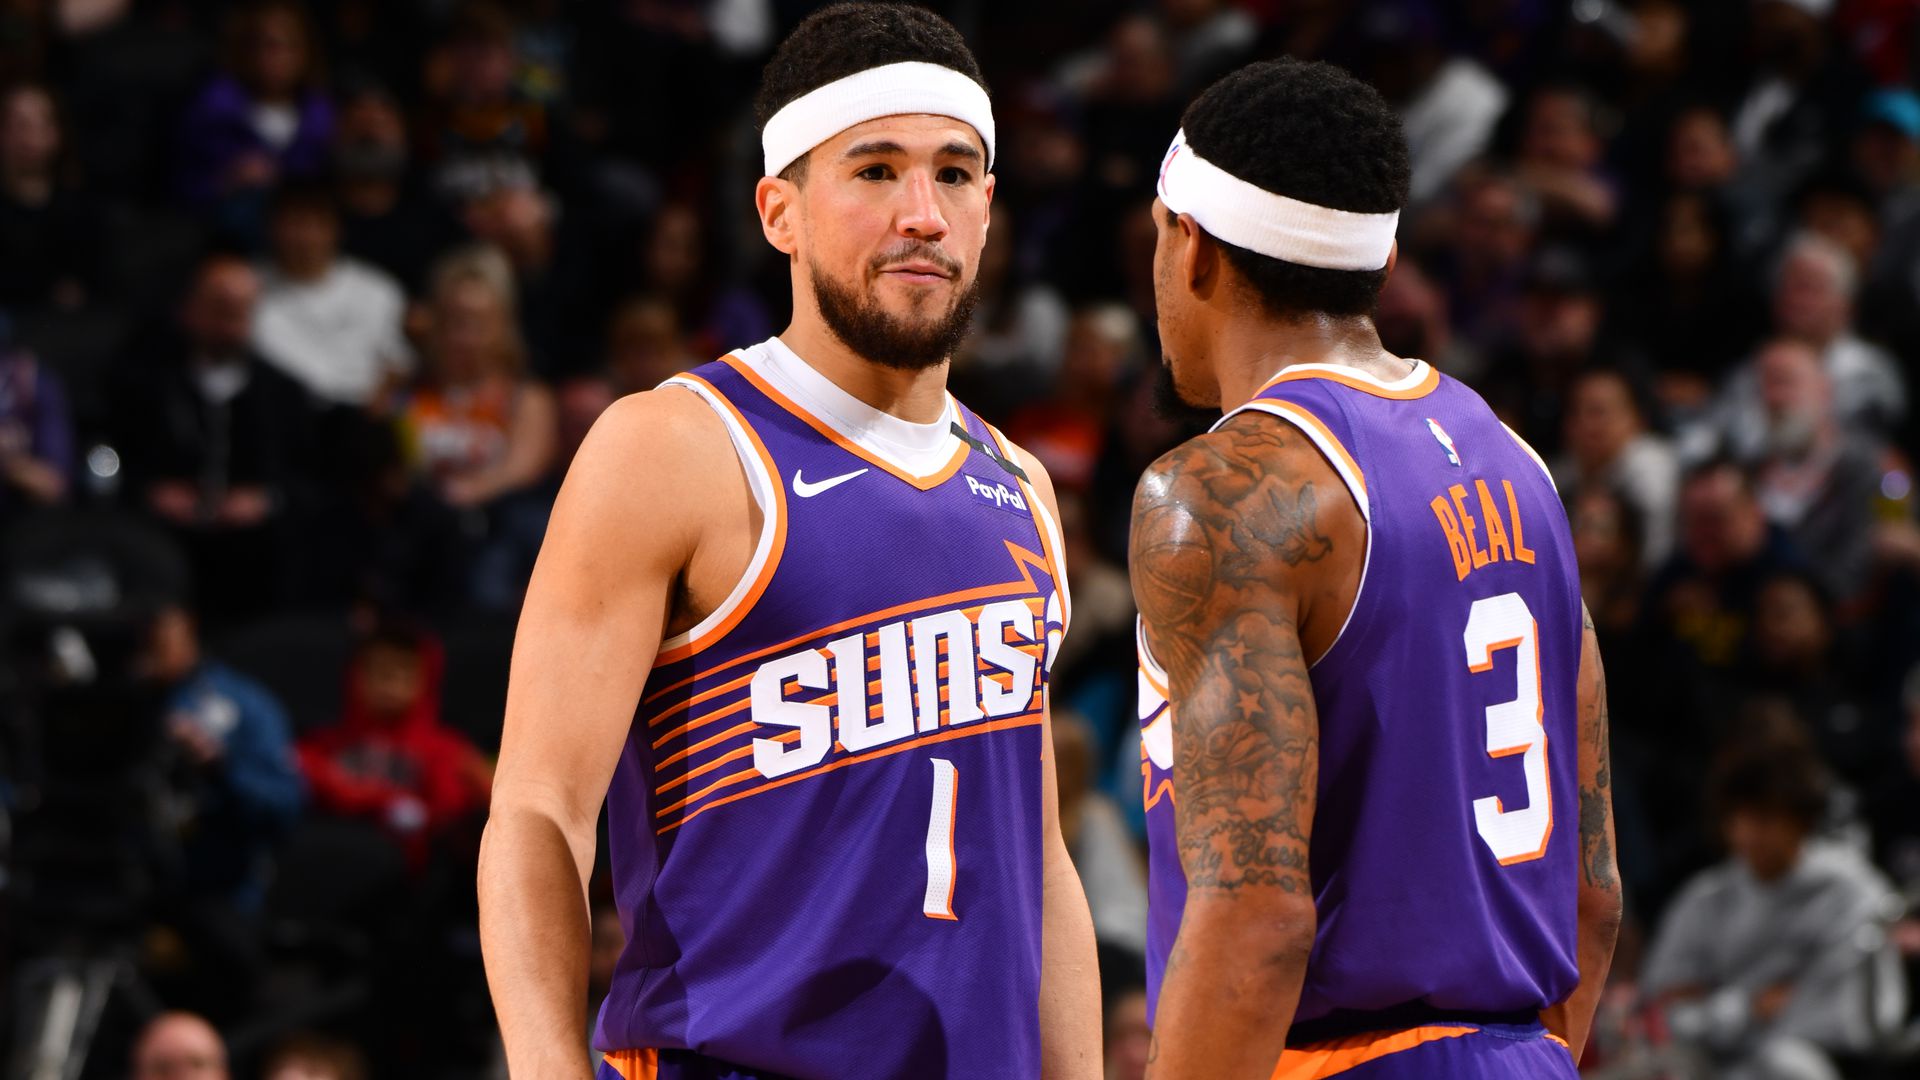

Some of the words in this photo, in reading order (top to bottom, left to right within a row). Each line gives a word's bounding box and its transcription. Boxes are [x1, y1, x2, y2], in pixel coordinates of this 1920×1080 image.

[964, 474, 1027, 511] PayPal
[1430, 479, 1535, 581] BEAL
[751, 599, 1037, 779] SUNS
[1463, 591, 1554, 867] 3
[923, 757, 958, 921] 1
